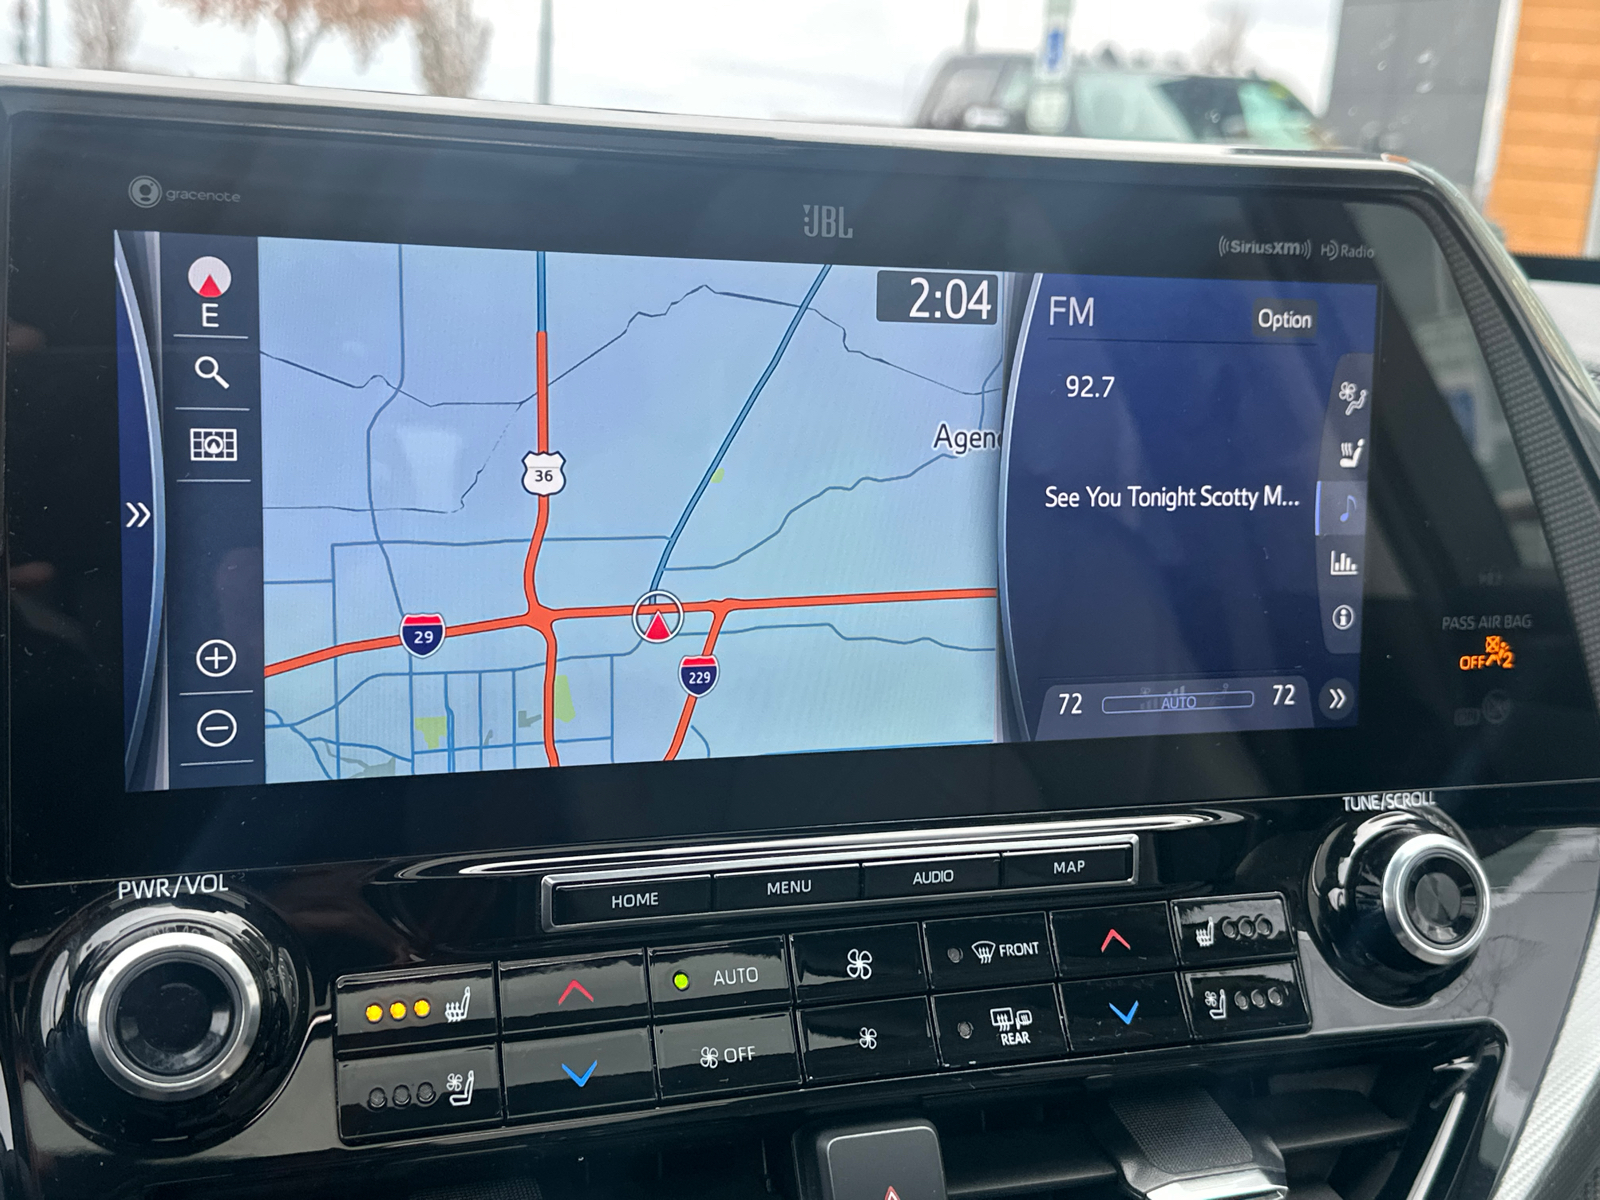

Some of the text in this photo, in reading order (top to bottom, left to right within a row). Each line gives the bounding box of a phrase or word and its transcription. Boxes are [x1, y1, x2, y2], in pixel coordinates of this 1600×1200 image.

[166, 188, 241, 203] gracenote
[803, 203, 854, 240] JBL
[1341, 244, 1376, 260] Radio
[909, 277, 992, 320] 2:04
[202, 303, 219, 327] E
[1048, 296, 1096, 328] FM
[1258, 308, 1312, 332] Option
[1065, 374, 1116, 400] 92.7
[534, 469, 554, 484] 36
[1044, 485, 1301, 513] See You Tonight Scotty M...
[1442, 613, 1532, 631] PASS AIR BAG
[413, 630, 435, 645] 29
[1459, 654, 1486, 671] OFF
[688, 671, 711, 686] 229
[1058, 692, 1083, 715] 72
[1161, 695, 1197, 710] AUTO
[1272, 684, 1296, 707] 72
[1343, 791, 1436, 812] TUNE/SCROLL
[1052, 858, 1086, 875] MAP
[912, 868, 955, 886] AUDIO
[117, 873, 229, 901] PWR/VOL
[766, 878, 812, 896] MENU
[611, 892, 659, 909] HOME
[999, 940, 1040, 958] FRONT
[713, 967, 759, 985] AUTO
[1000, 1031, 1031, 1046] REAR
[724, 1046, 755, 1064] OFF
